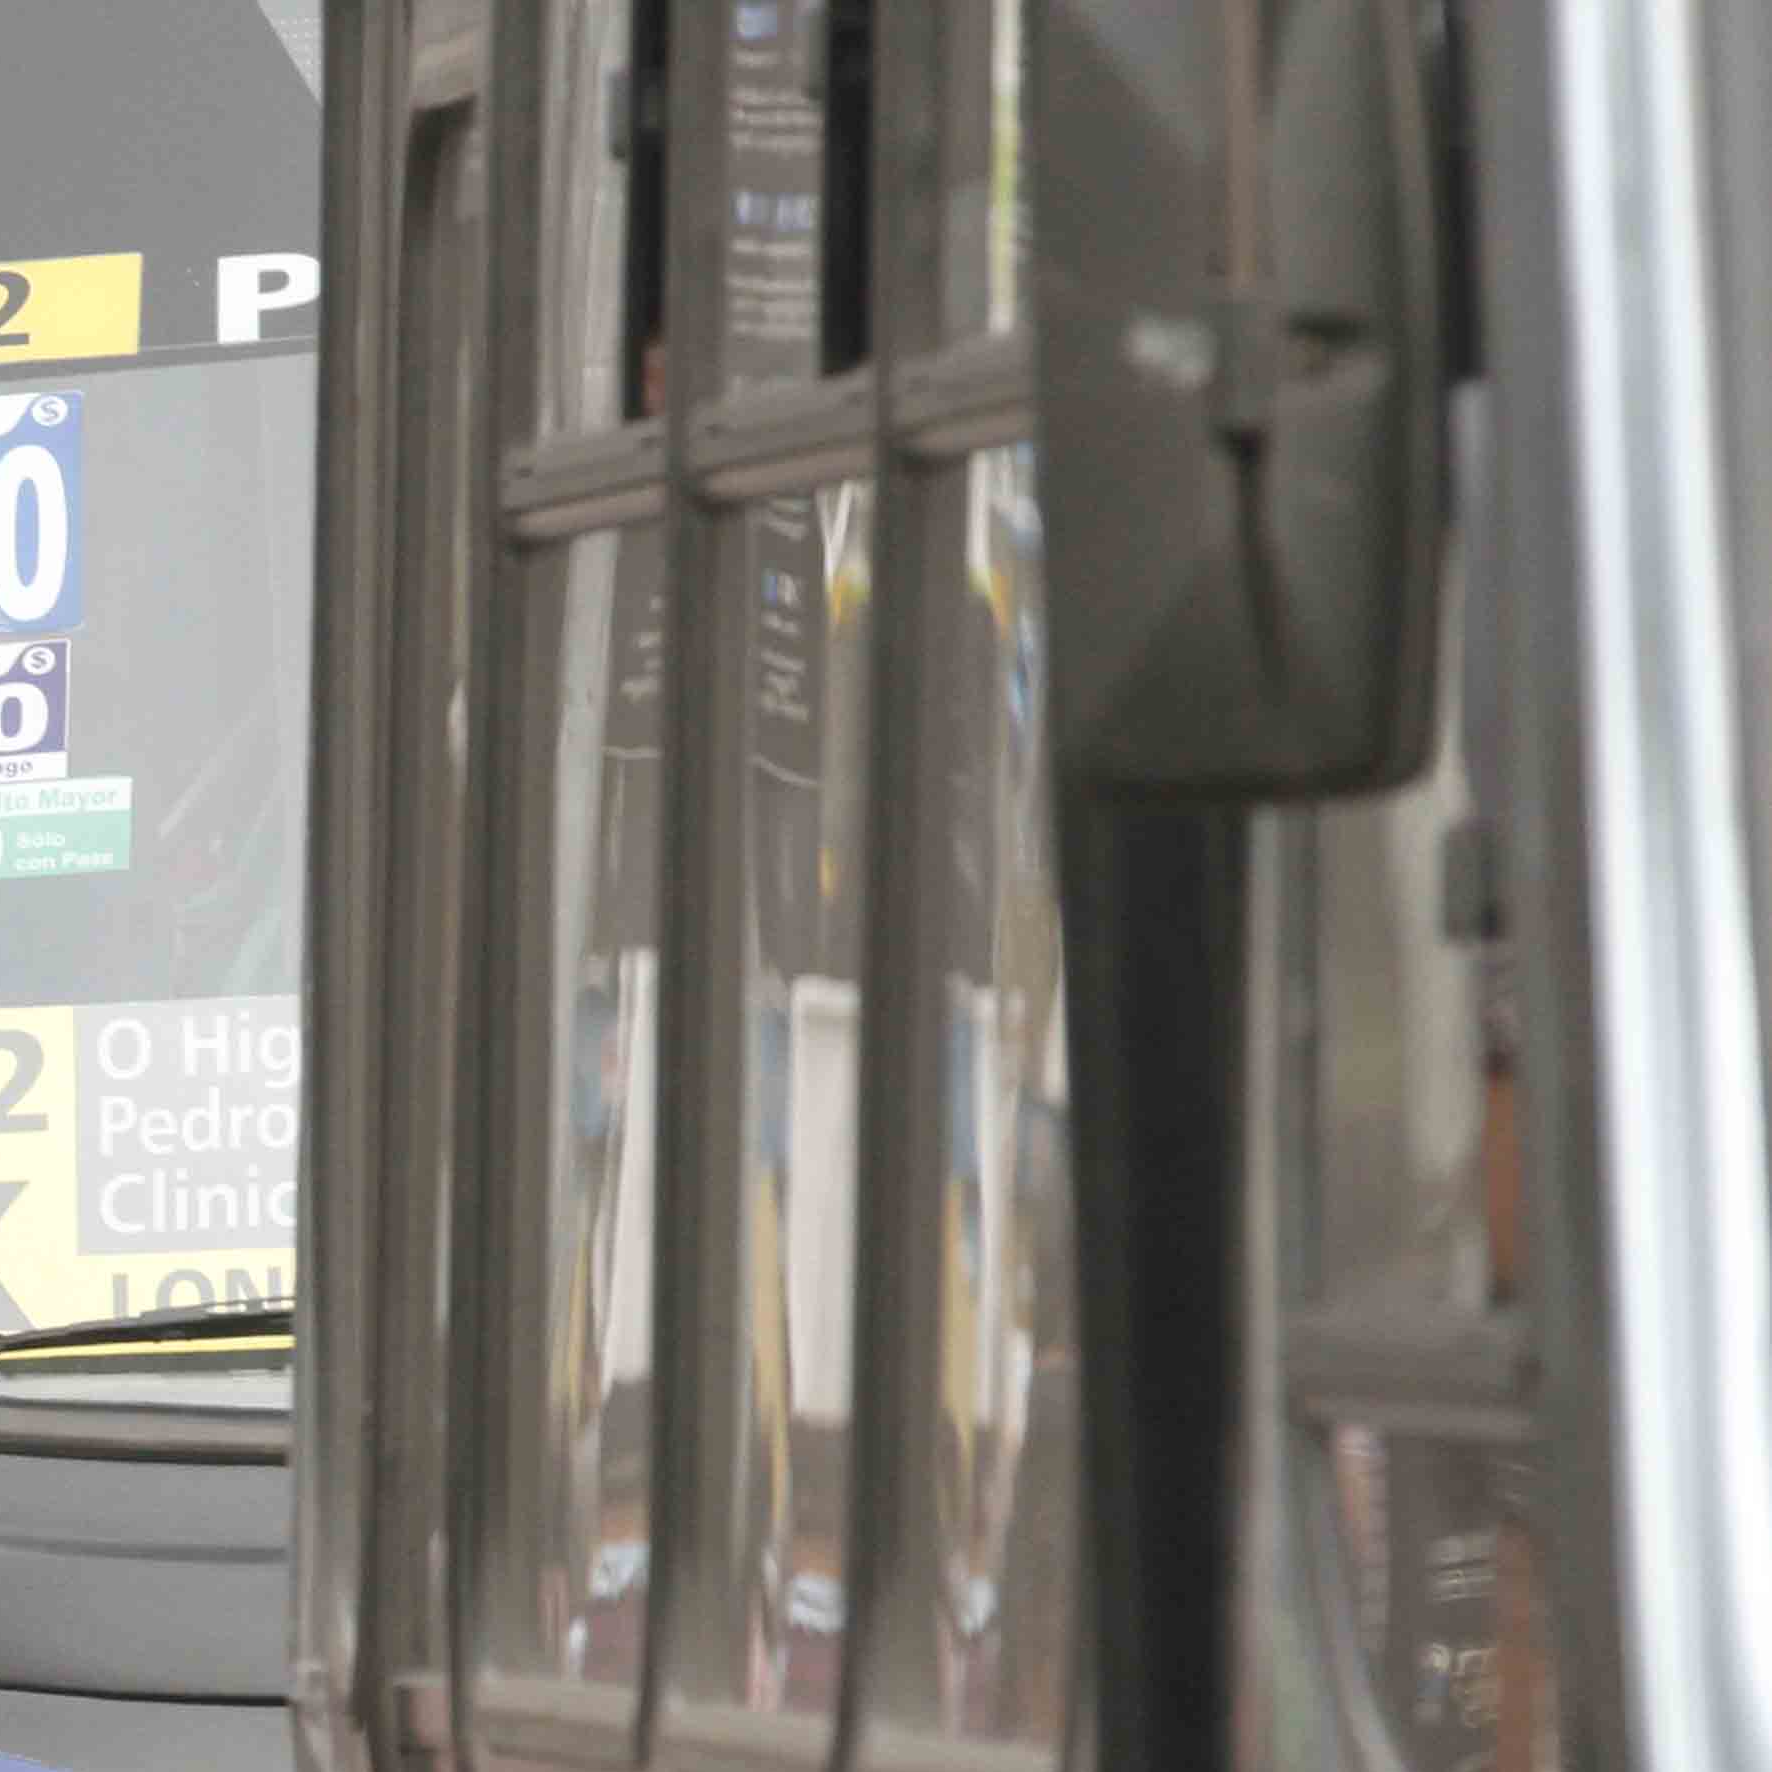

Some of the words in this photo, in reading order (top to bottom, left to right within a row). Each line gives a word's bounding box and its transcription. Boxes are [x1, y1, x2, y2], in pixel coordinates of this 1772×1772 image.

[217, 253, 320, 345] P
[38, 787, 118, 813] Mayor
[15, 855, 56, 872] con
[97, 1017, 152, 1081] O
[180, 1010, 302, 1090] Hig
[99, 1085, 299, 1158] Pedro
